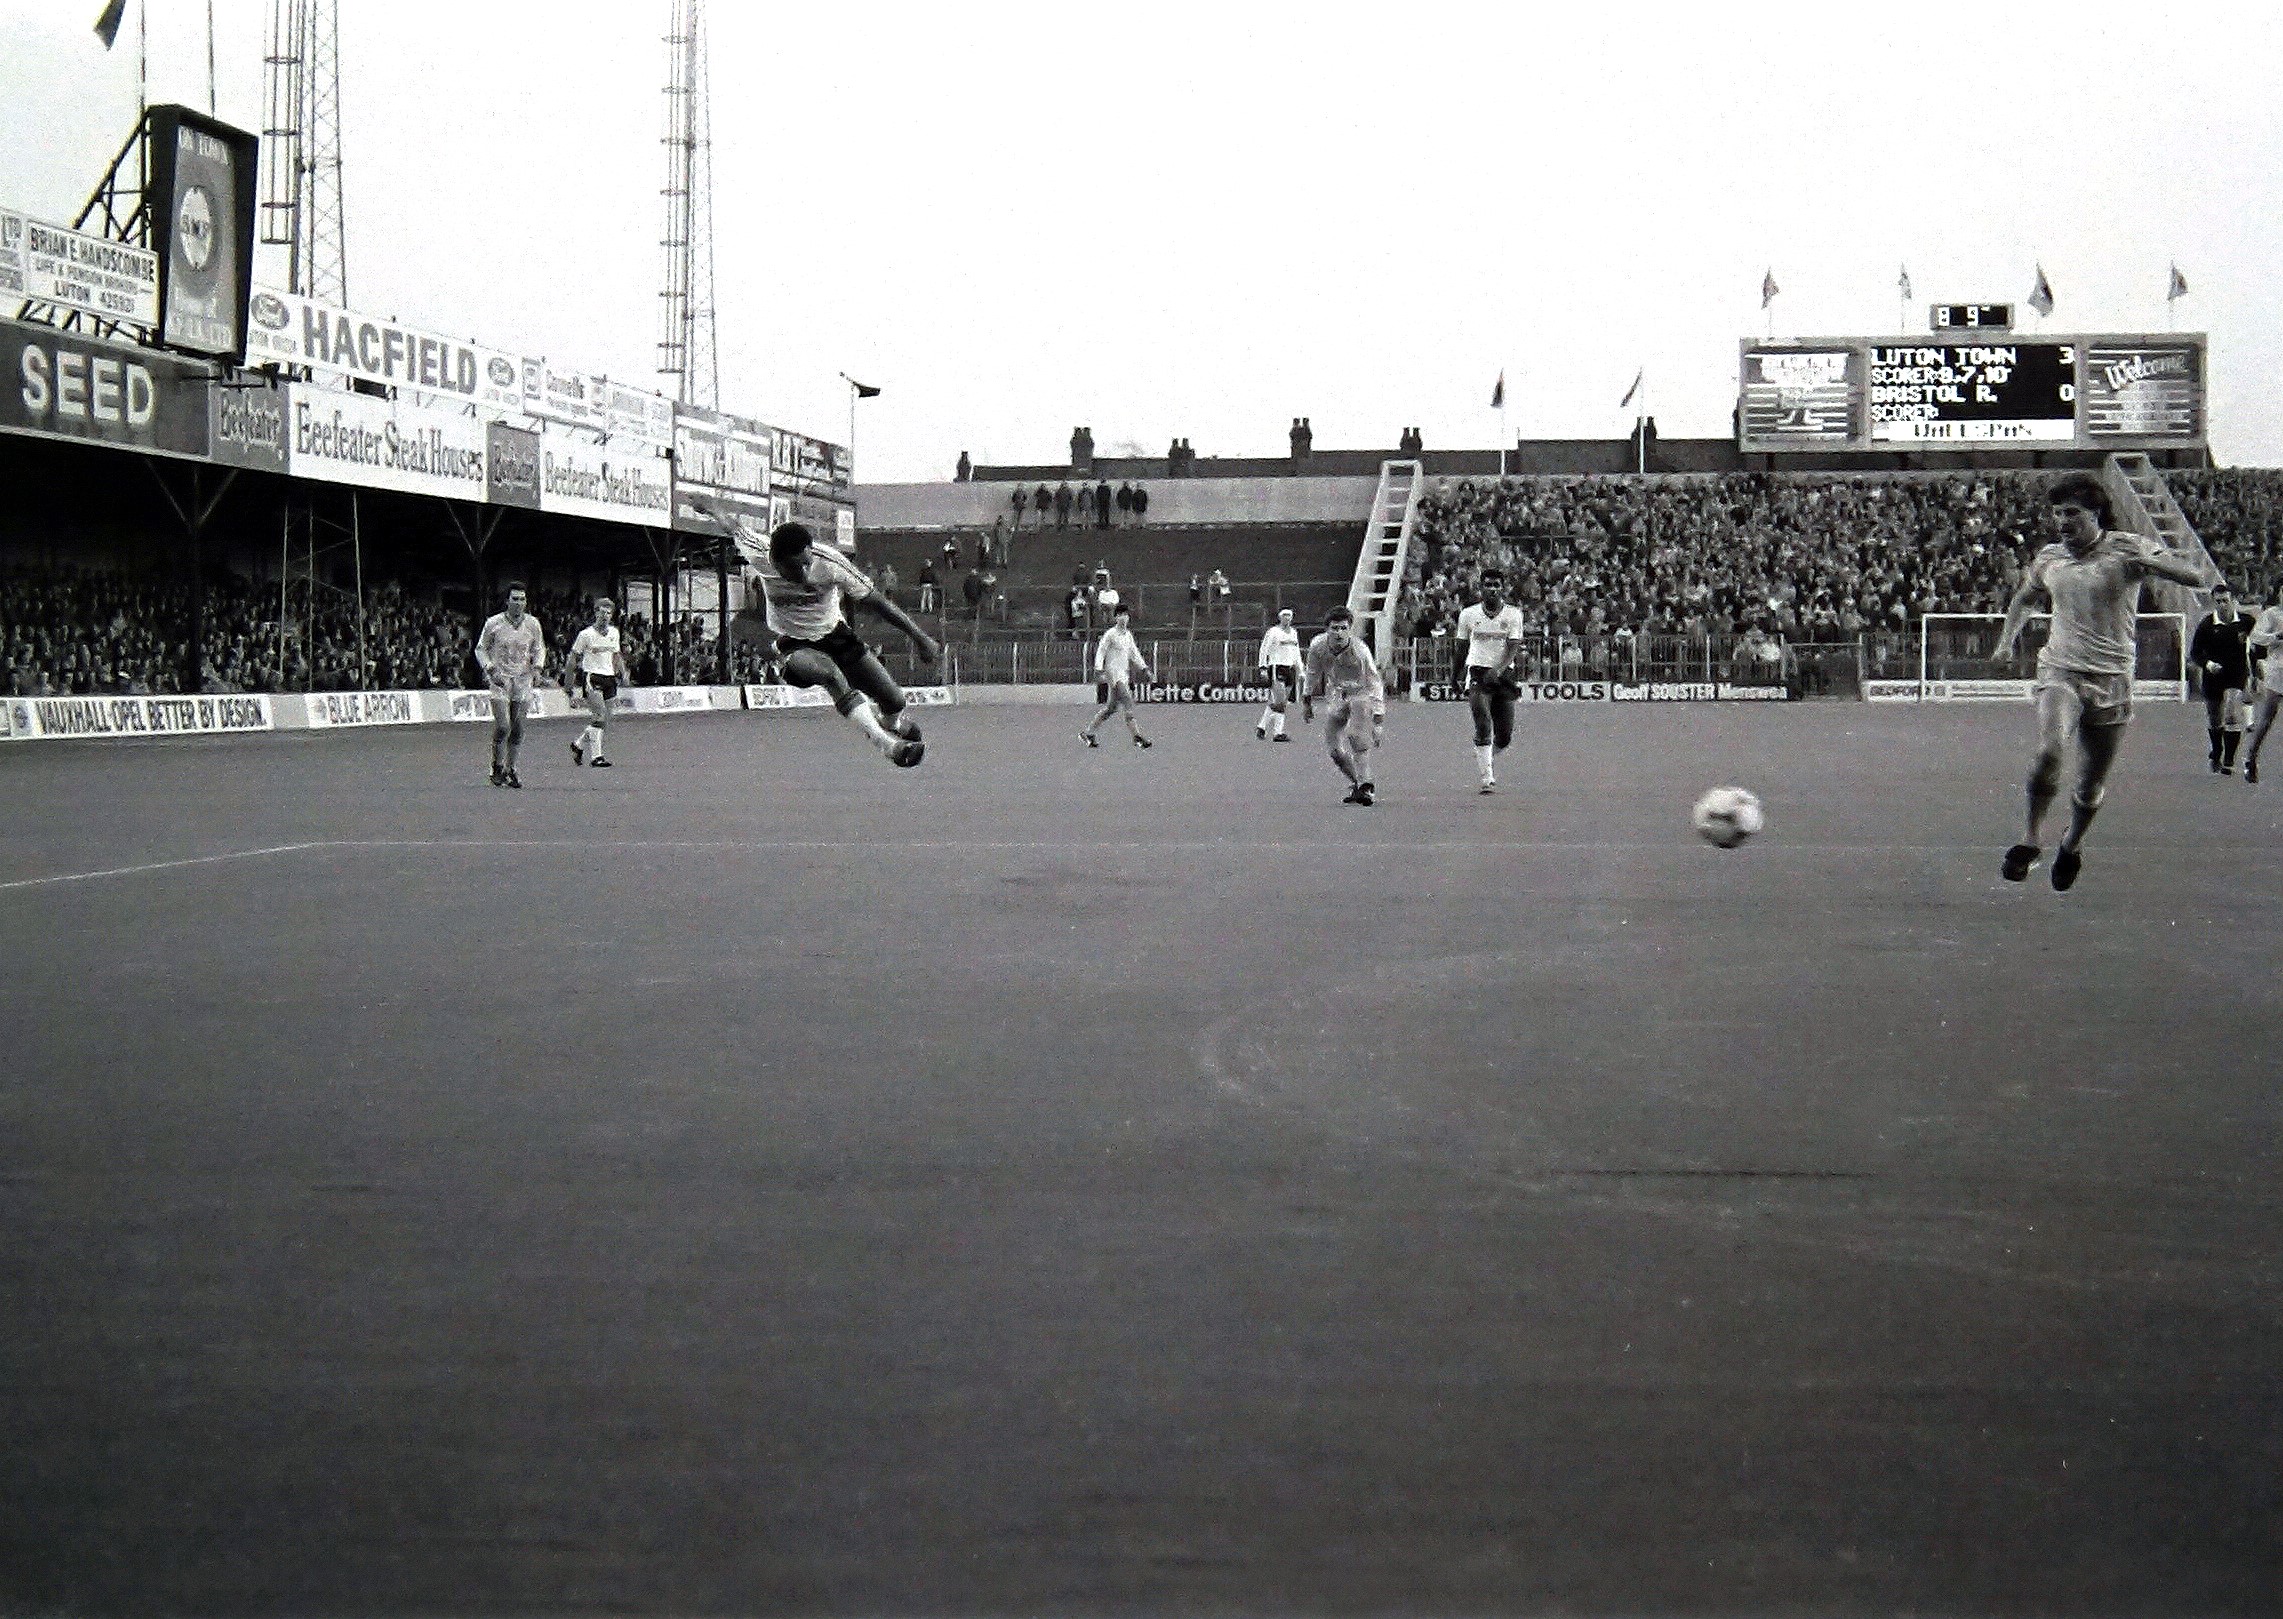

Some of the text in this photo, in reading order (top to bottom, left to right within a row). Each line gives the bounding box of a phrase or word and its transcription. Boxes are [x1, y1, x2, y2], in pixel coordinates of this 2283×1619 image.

[30, 227, 68, 259] BRIAN
[69, 238, 78, 262] E
[79, 238, 155, 283] HANDSCOMBE
[54, 280, 92, 304] LUTON
[302, 305, 477, 396] HACFIELD
[1871, 346, 2075, 367] LUTON TOWN 3
[22, 344, 154, 424] SEED
[1872, 384, 1966, 403] BRISTOL
[1976, 385, 1998, 403] R.
[295, 400, 382, 466] Beefeater
[1132, 682, 1271, 702] illette Contou
[1529, 684, 1605, 700] TOOLS
[36, 700, 111, 735] VAUXHALL
[111, 700, 146, 732] OPEL
[147, 699, 196, 731] BETTER
[198, 699, 216, 728] BY
[218, 698, 267, 728] DESIGN
[327, 693, 411, 724] BLUE ARROW
